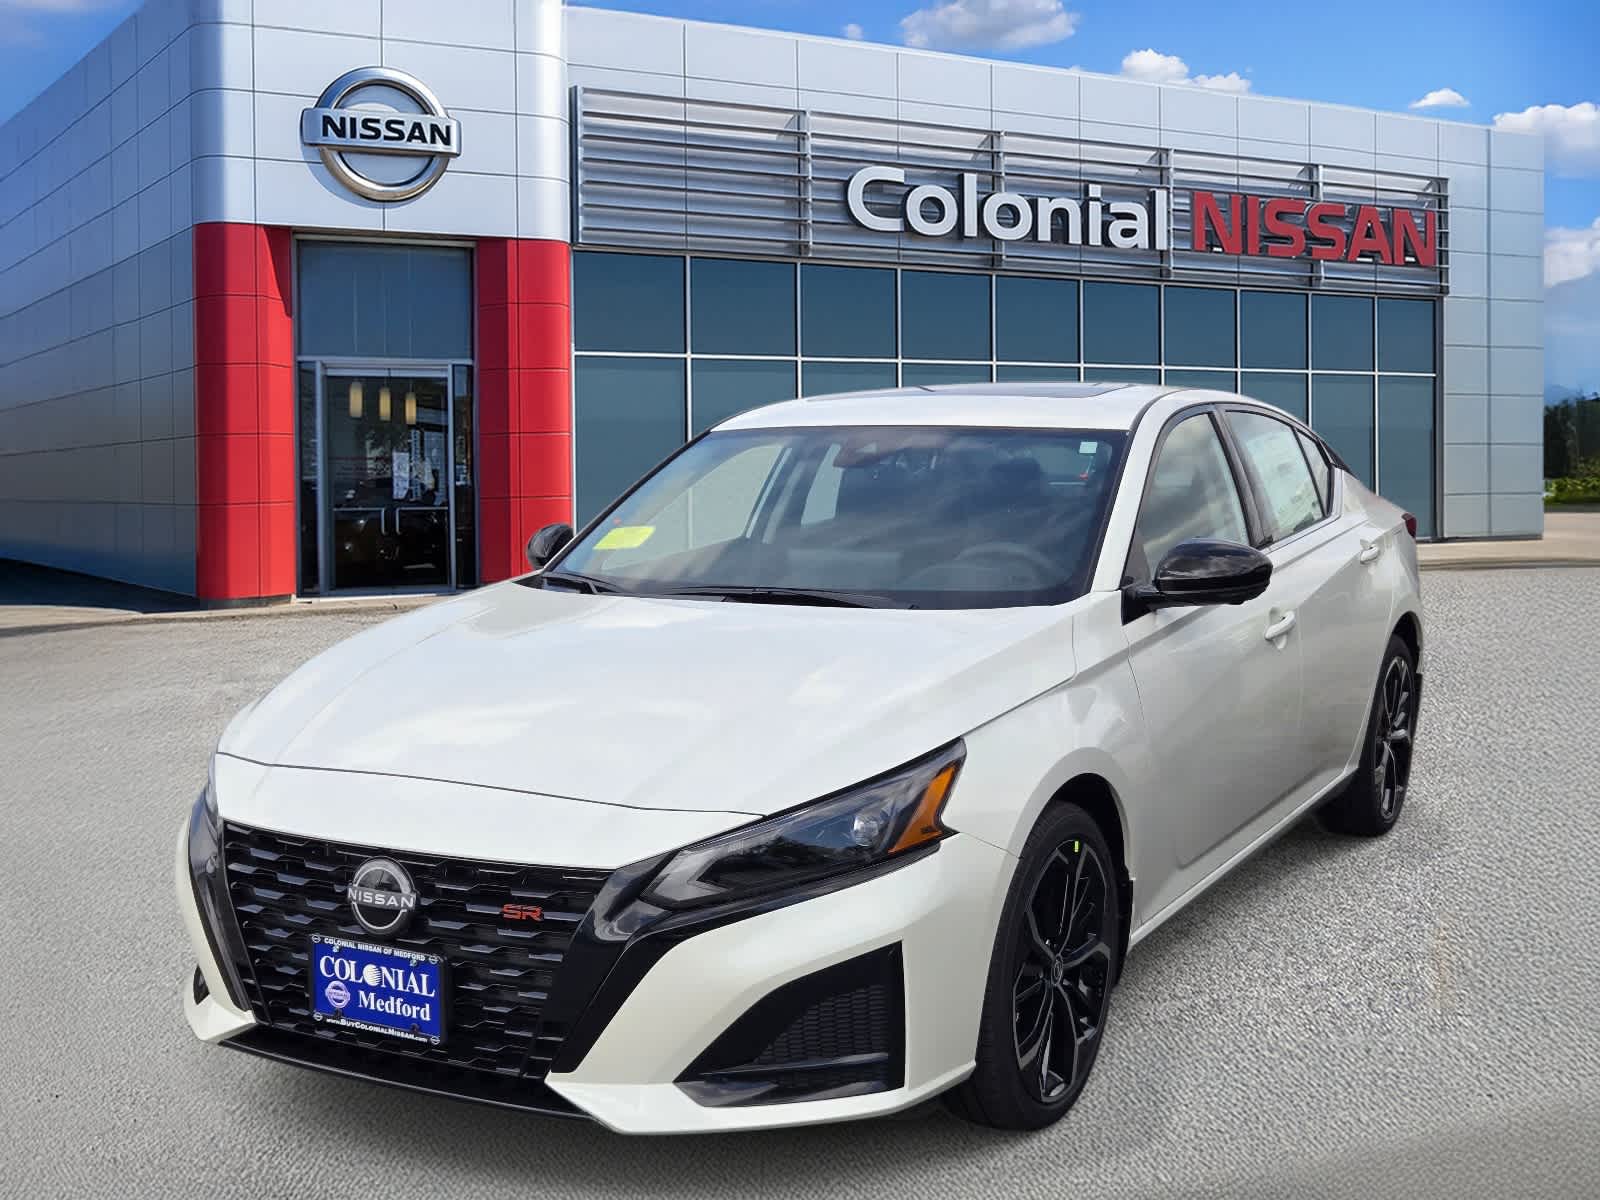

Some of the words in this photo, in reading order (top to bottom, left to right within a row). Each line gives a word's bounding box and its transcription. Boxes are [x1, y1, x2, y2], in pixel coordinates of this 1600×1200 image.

[322, 115, 451, 146] NISSAN
[846, 165, 1168, 250] Colonial
[1191, 191, 1436, 267] NISSAN
[348, 887, 414, 908] NISSAN
[502, 903, 544, 921] SR
[324, 937, 356, 949] COLONIAL
[357, 943, 381, 953] NISSAN
[383, 947, 392, 956] OF
[393, 950, 426, 962] MEDFORD
[319, 955, 436, 998] COLONIAL
[358, 990, 431, 1022] Medford
